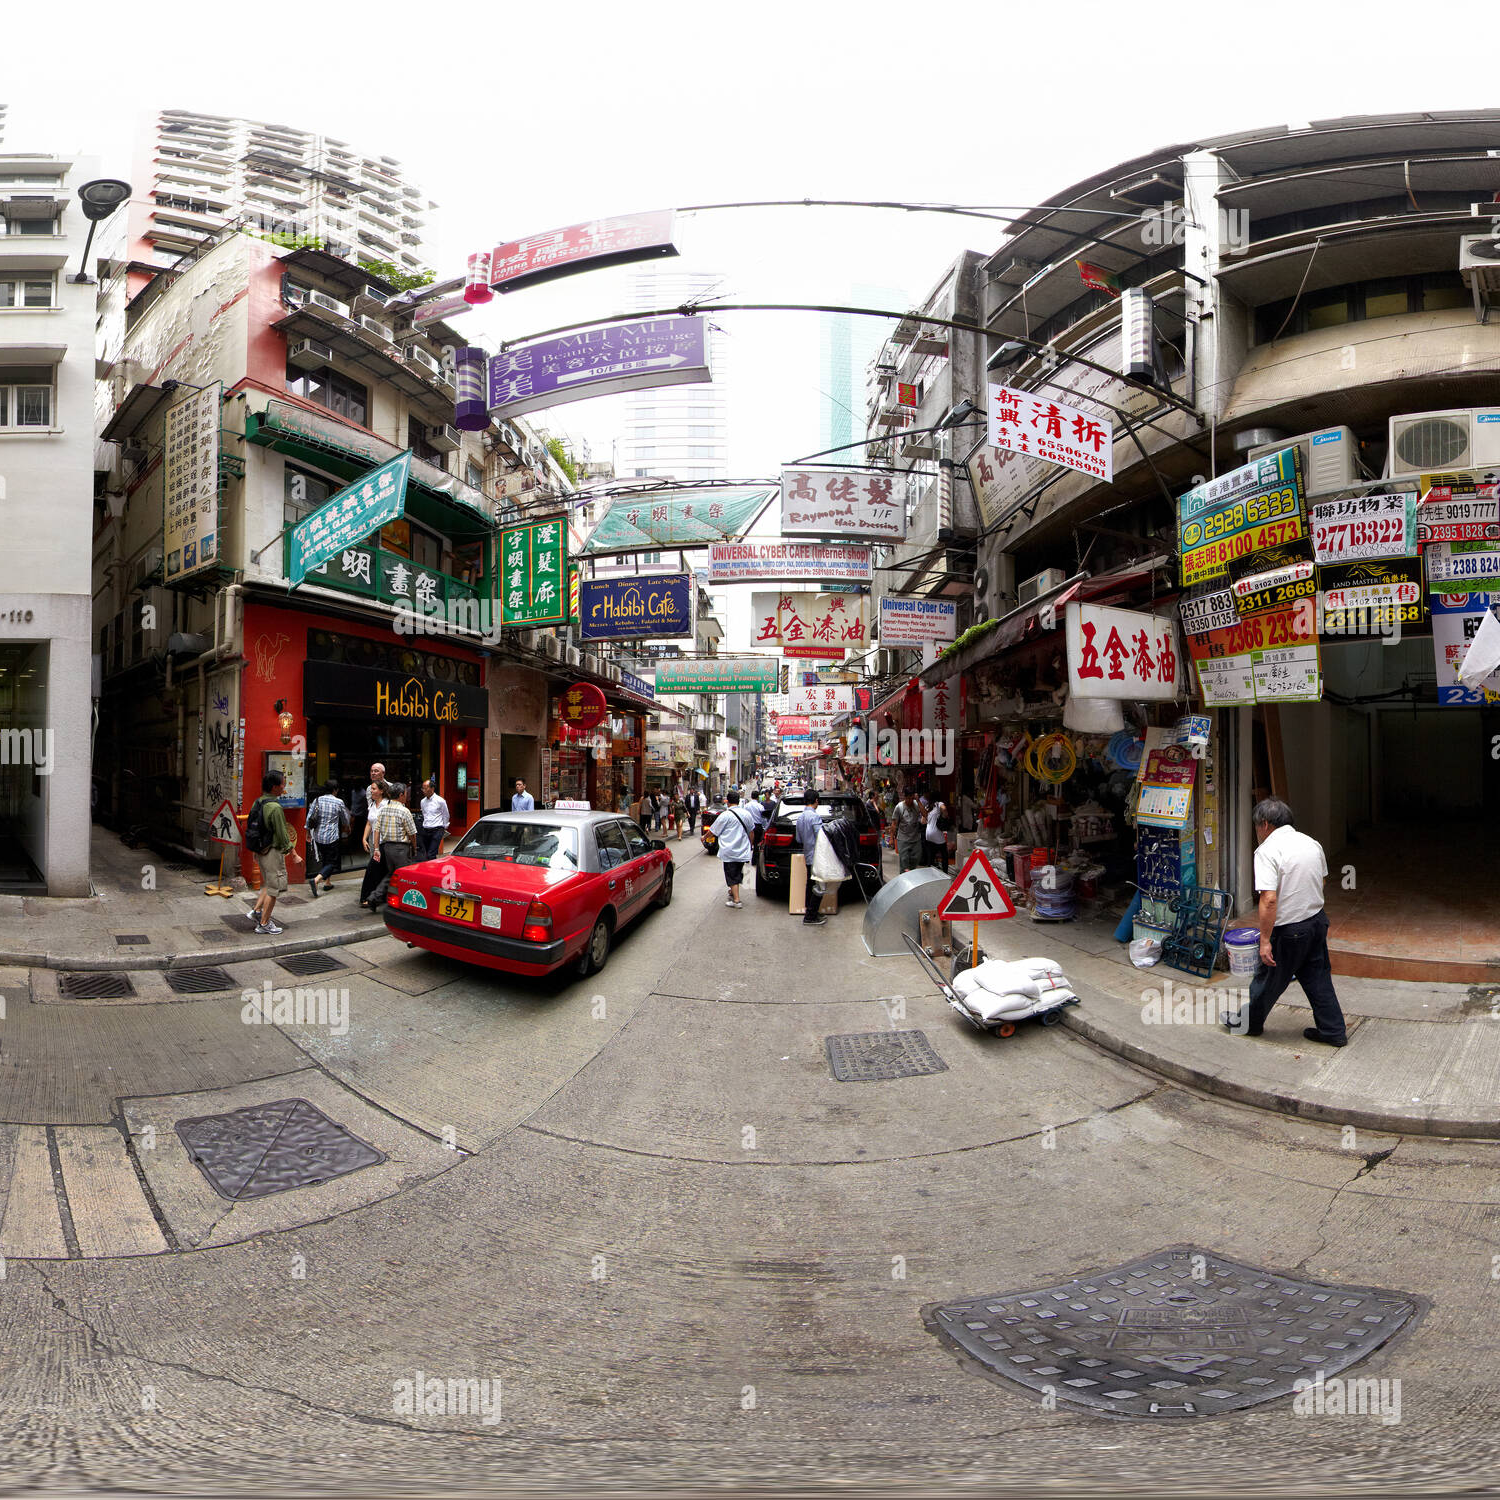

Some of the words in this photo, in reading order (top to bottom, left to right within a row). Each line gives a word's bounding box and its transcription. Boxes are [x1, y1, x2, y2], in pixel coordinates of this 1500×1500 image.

[557, 329, 609, 351] MEI
[619, 319, 674, 338] MEI
[542, 345, 576, 363] Beauty
[601, 341, 614, 350] &
[622, 333, 696, 346] Massage
[588, 364, 616, 376] 10/F
[994, 388, 1023, 428] 新興
[1030, 401, 1107, 453] 清拆
[1037, 437, 1107, 468] 65506788
[1038, 448, 1107, 478] 66838991
[788, 473, 900, 508] 高佬髮
[1208, 469, 1254, 498] 香港置業
[626, 502, 725, 526] 宇明畫架
[788, 503, 854, 524] Raymond
[872, 508, 893, 519] 1/F
[1203, 503, 1245, 541] 2928
[1246, 488, 1296, 524] 6333
[1315, 495, 1404, 519] 聯坊物業
[1446, 503, 1471, 519] 9019
[1472, 502, 1497, 518] 7777
[834, 518, 856, 527] Hair
[858, 519, 899, 532] Dressing
[1433, 525, 1457, 539] 2395
[1459, 524, 1484, 538] 1828
[1218, 532, 1253, 563] 8100
[1257, 520, 1299, 549] 4573
[712, 545, 758, 561] UNIVERSAL
[759, 544, 787, 559] CYBER
[789, 544, 810, 559] CAFE
[812, 545, 846, 560] (Internet
[847, 547, 869, 564] shop)
[506, 531, 525, 609] 宇明畫架
[1452, 558, 1477, 575] 2388
[663, 578, 681, 586] Night
[1254, 580, 1272, 590] 8102
[1274, 574, 1292, 585] 0801
[1333, 579, 1351, 588] LAND
[1352, 574, 1379, 585] MASTER
[1381, 574, 1409, 584] 伯樂行
[1237, 591, 1271, 612] 2311
[1276, 580, 1316, 601] 2668
[1326, 588, 1347, 609] 租
[1348, 597, 1370, 606] 8102
[1395, 583, 1416, 602] 售
[603, 593, 645, 619] Habibi
[647, 590, 677, 617] Café
[882, 598, 916, 611] Universal
[917, 601, 937, 613] Cyber
[1180, 598, 1207, 619] 2517
[1190, 617, 1210, 632] 9350
[1211, 612, 1232, 628] 0135
[1325, 609, 1365, 628] 2311
[1373, 605, 1419, 623] 2668
[756, 613, 867, 643] 五金漆油
[1227, 617, 1264, 654] 2366
[1077, 621, 1176, 685] 五金漆油
[377, 680, 429, 719] Habibi
[434, 690, 460, 724] Café
[557, 802, 574, 810] TAXI
[445, 906, 468, 920] 977
